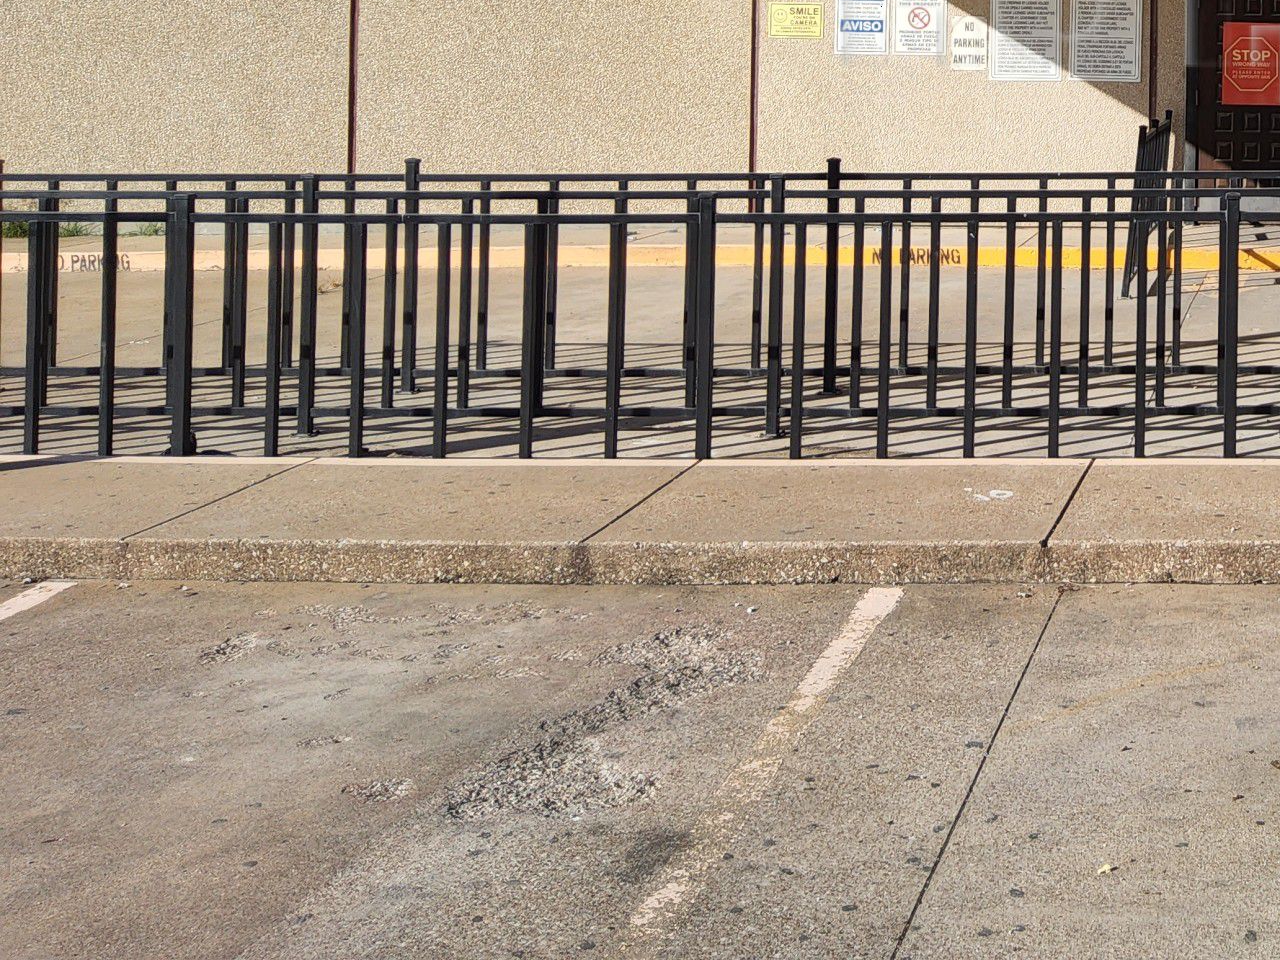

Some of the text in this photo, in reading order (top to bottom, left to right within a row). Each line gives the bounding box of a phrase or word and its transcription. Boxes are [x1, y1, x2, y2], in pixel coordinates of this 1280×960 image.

[789, 7, 819, 15] SMILE
[843, 21, 882, 31] AVISO
[965, 22, 975, 31] NO
[954, 38, 985, 48] PARKING
[953, 54, 985, 64] ANYTIME
[1232, 49, 1271, 61] STOP
